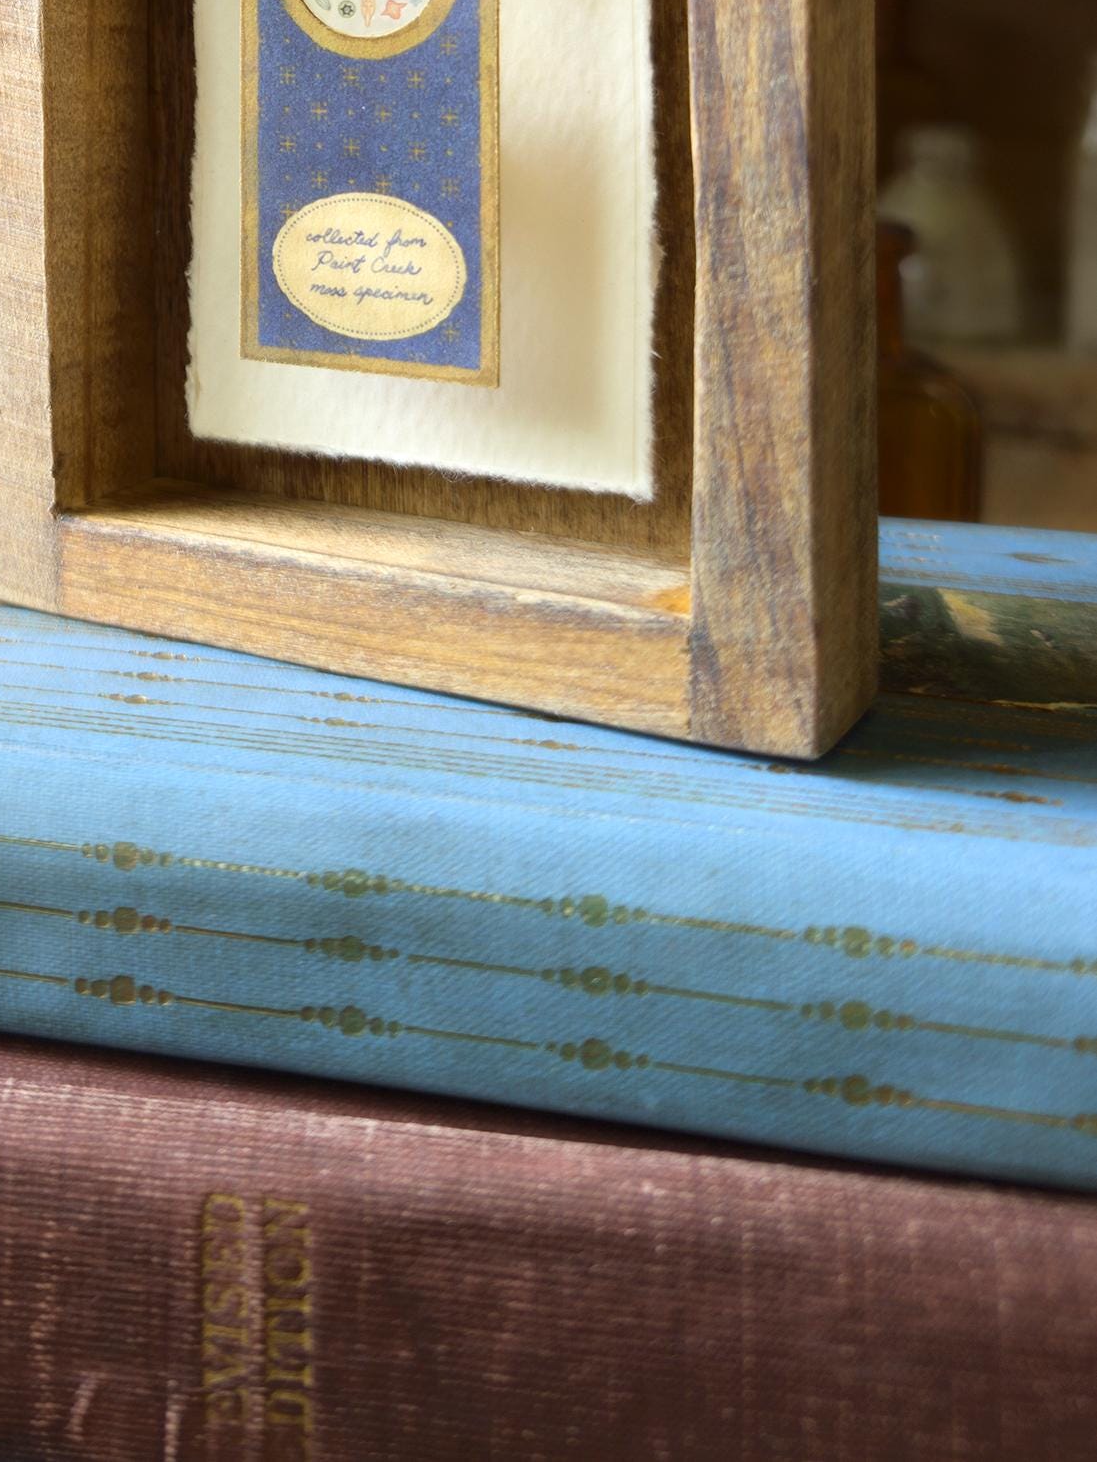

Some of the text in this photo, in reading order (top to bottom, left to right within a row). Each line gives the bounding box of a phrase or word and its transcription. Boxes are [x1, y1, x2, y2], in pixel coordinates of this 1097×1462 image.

[306, 227, 427, 258] collected from
[353, 285, 434, 306] specimen
